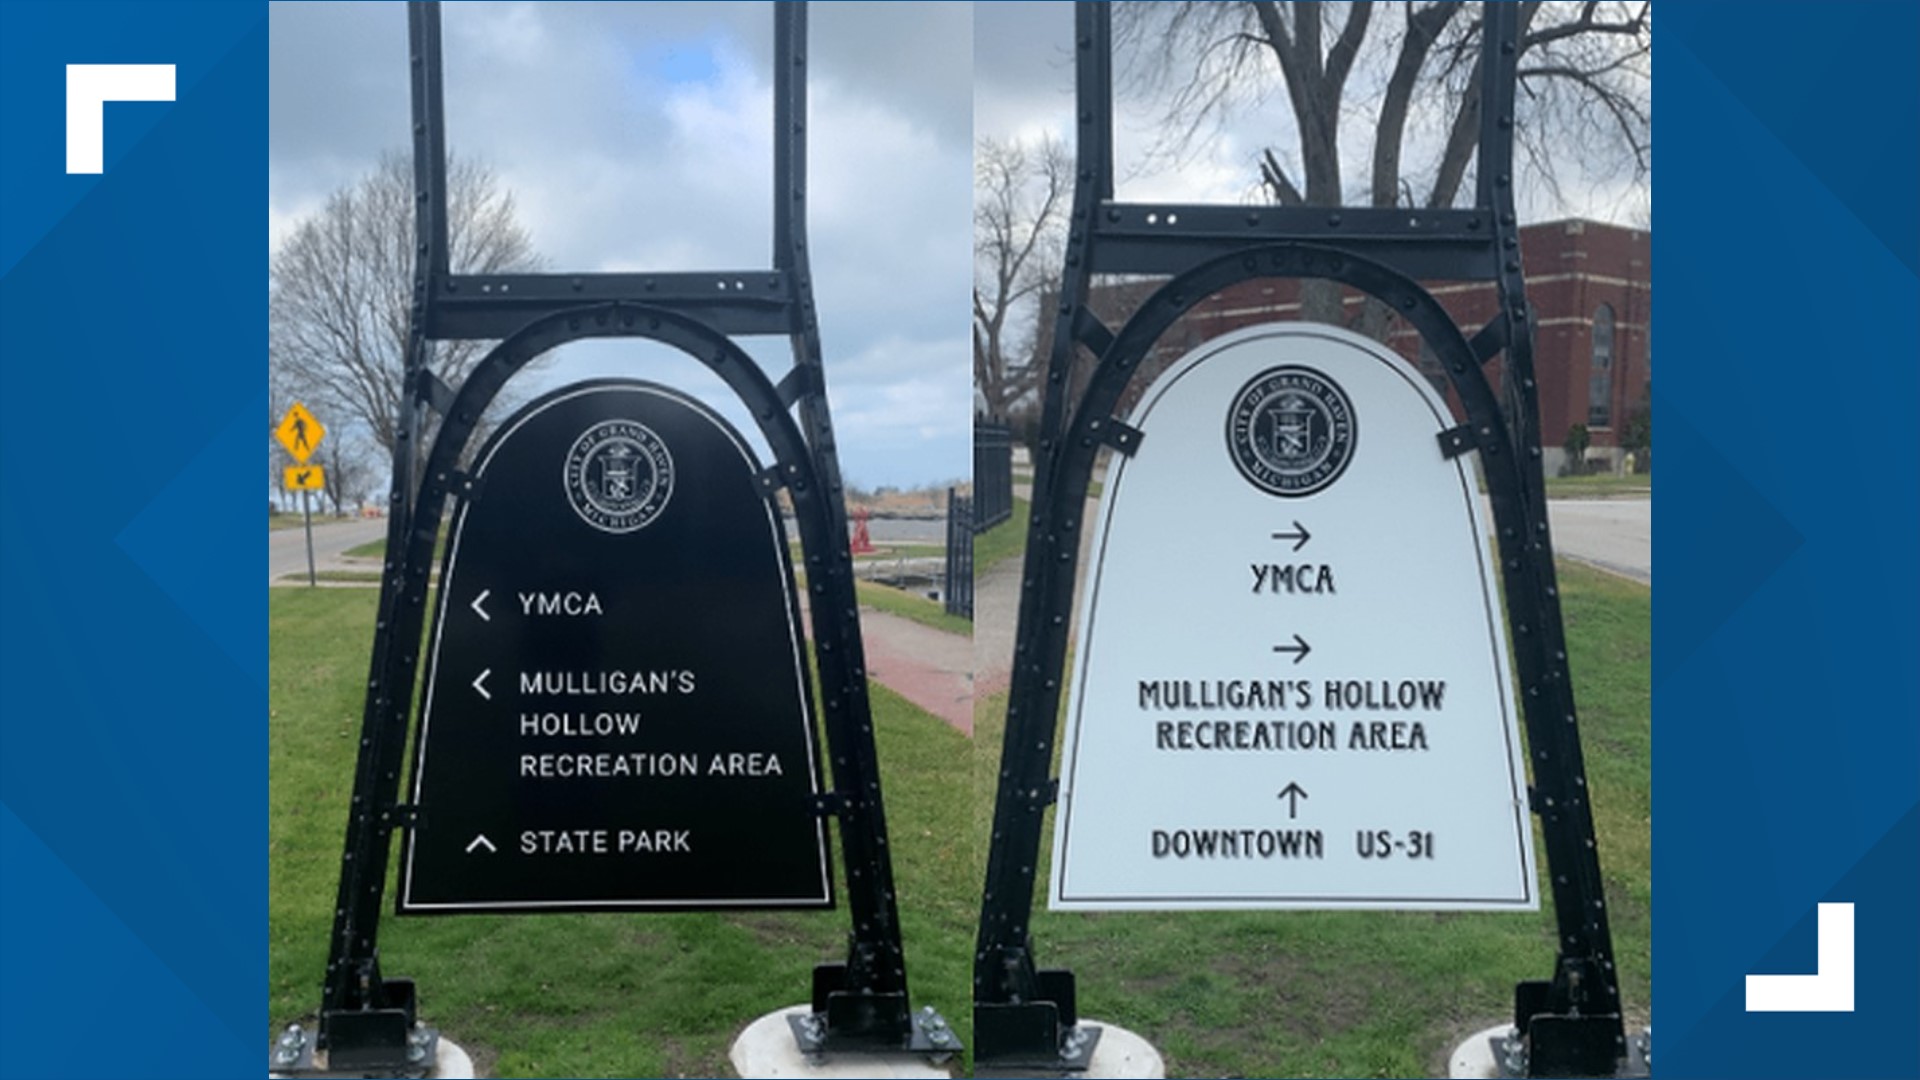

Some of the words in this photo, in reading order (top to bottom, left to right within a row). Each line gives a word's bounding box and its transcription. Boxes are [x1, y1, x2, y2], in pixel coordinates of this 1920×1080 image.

[1235, 409, 1250, 444] CITY
[1247, 387, 1265, 405] OF
[1268, 376, 1324, 394] GRAND
[1324, 393, 1349, 443] HAVEN
[580, 434, 596, 452] OF
[1250, 460, 1333, 488] MICHIGAN
[1251, 564, 1336, 595] YMCA
[518, 591, 603, 616] YMCA
[520, 669, 696, 695] MULLIGAN'S
[1138, 680, 1311, 711] MULLIGAN'S
[1324, 680, 1446, 711] HOLLOW
[520, 711, 642, 736] HOLLOW
[1156, 720, 1337, 751] RECREATION
[1348, 720, 1429, 751] AREA
[520, 752, 699, 777] RECREATION
[708, 752, 784, 777] AREA
[520, 830, 608, 854] STATE
[618, 830, 691, 853] PARK
[1151, 829, 1324, 860] DOWNTOWN
[1356, 829, 1434, 860] US-31
